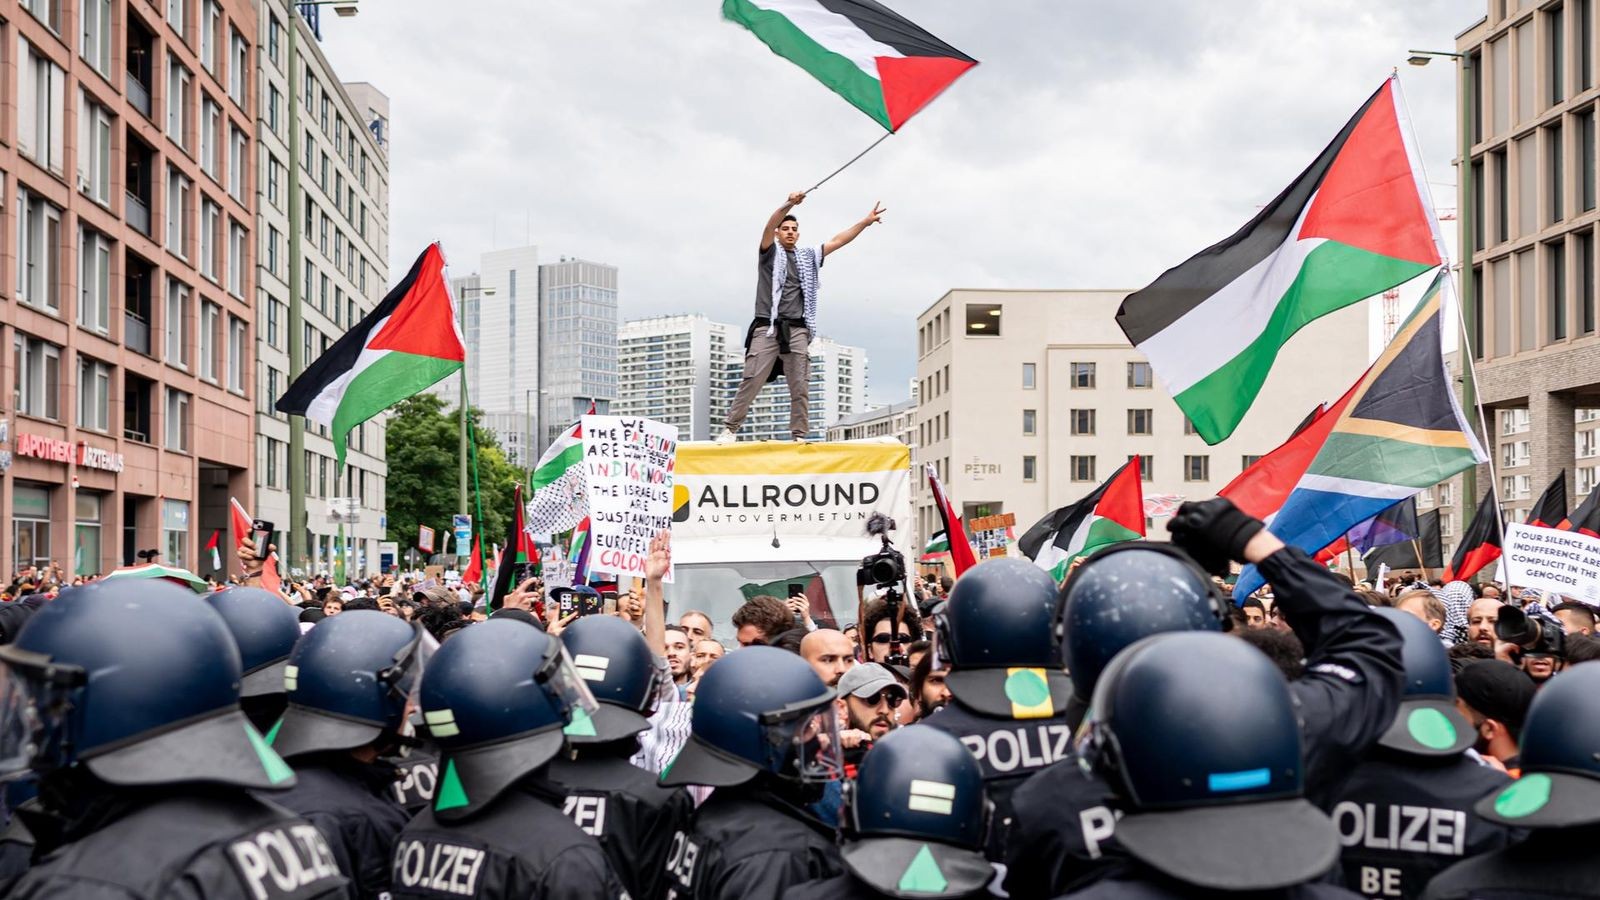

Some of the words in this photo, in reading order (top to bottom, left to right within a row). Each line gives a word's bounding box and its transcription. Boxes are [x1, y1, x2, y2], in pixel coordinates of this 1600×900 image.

[589, 428, 617, 440] THE
[620, 419, 644, 433] WE
[18, 433, 76, 464] APOTHEKE
[587, 442, 619, 457] ARE
[590, 460, 674, 488] INDIGENOUS
[964, 463, 1002, 474] PETRI
[593, 485, 618, 497] THE
[624, 485, 669, 503] ISRAELIS
[697, 482, 880, 508] ALLROUND
[629, 499, 649, 512] ARE
[698, 512, 866, 523] AUTOVERMIETUN
[624, 524, 655, 538] BRUTA
[596, 534, 648, 556] EUROPE
[1515, 530, 1543, 542] YOUR
[1544, 535, 1583, 549] SILENCE
[1584, 544, 1600, 555] AN
[1513, 542, 1581, 562] INDIFFERENCE
[1582, 556, 1600, 568] ARE
[1511, 554, 1566, 570] COMPLICIT
[1567, 564, 1578, 574] IN
[1580, 567, 1598, 579] THE
[1526, 568, 1577, 586] GENOCIDE
[959, 724, 1072, 772] POLIZ
[1332, 800, 1467, 856] OLIZEI
[1360, 865, 1402, 896] BE
